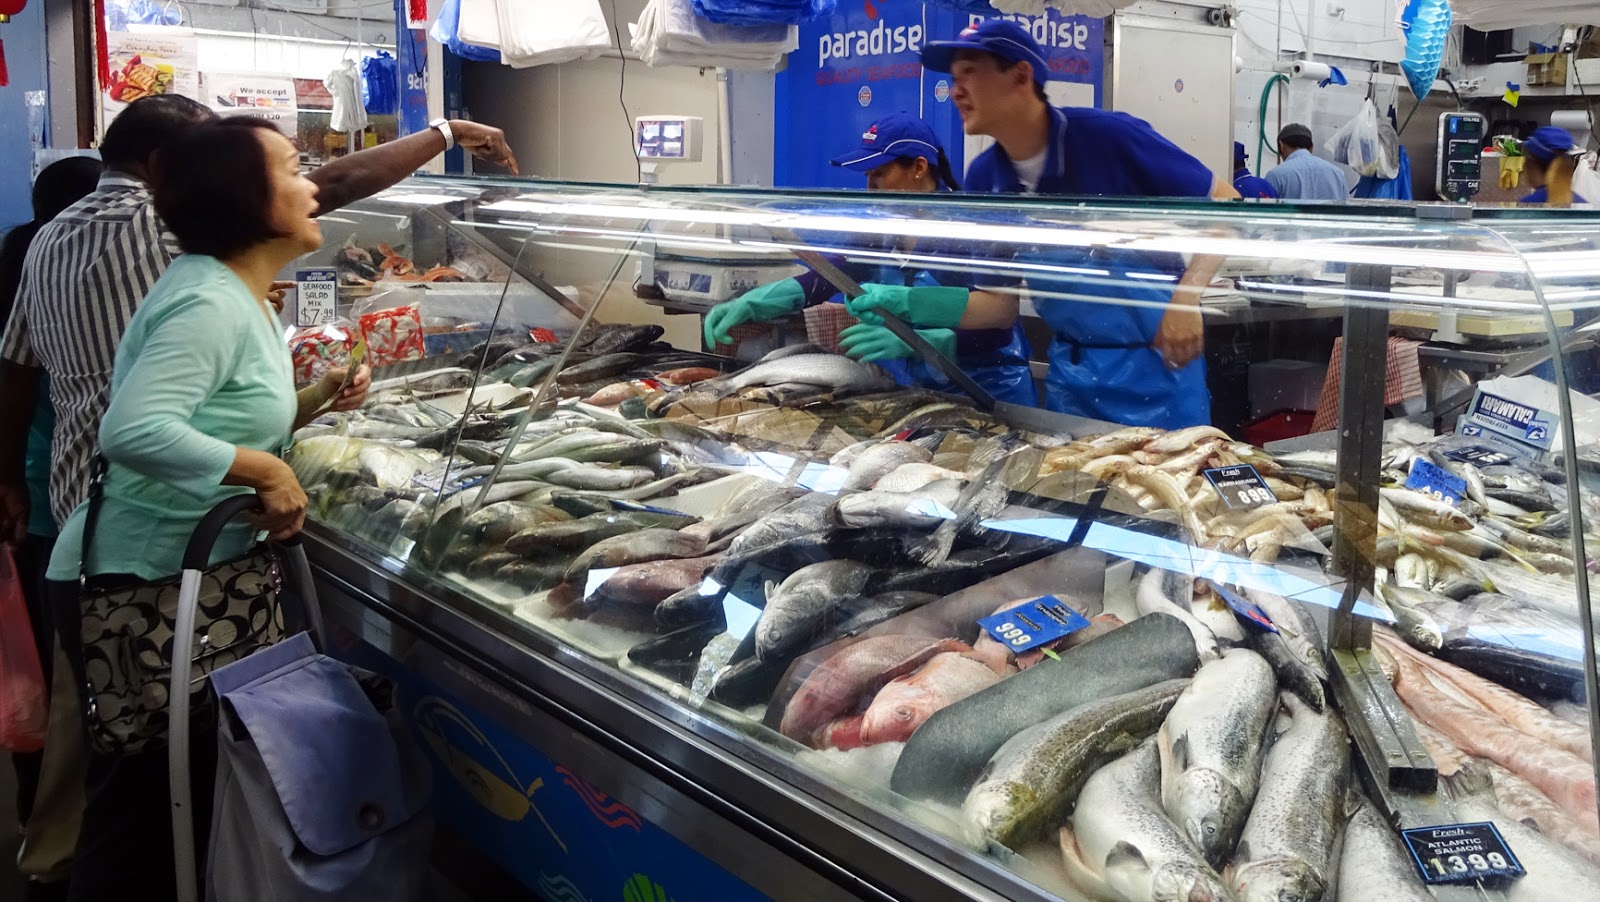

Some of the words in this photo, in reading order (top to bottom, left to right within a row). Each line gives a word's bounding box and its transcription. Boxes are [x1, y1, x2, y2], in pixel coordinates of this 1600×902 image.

[819, 19, 922, 68] paradise
[816, 66, 862, 86] QUALITY
[865, 62, 921, 81] SEAFOOD
[256, 88, 287, 96] accept
[305, 291, 329, 299] SALAD
[1480, 395, 1535, 425] CALAMARI
[1432, 828, 1465, 838] Fresh
[1428, 837, 1482, 849] ATLANTIC
[1434, 844, 1483, 855] SALMON
